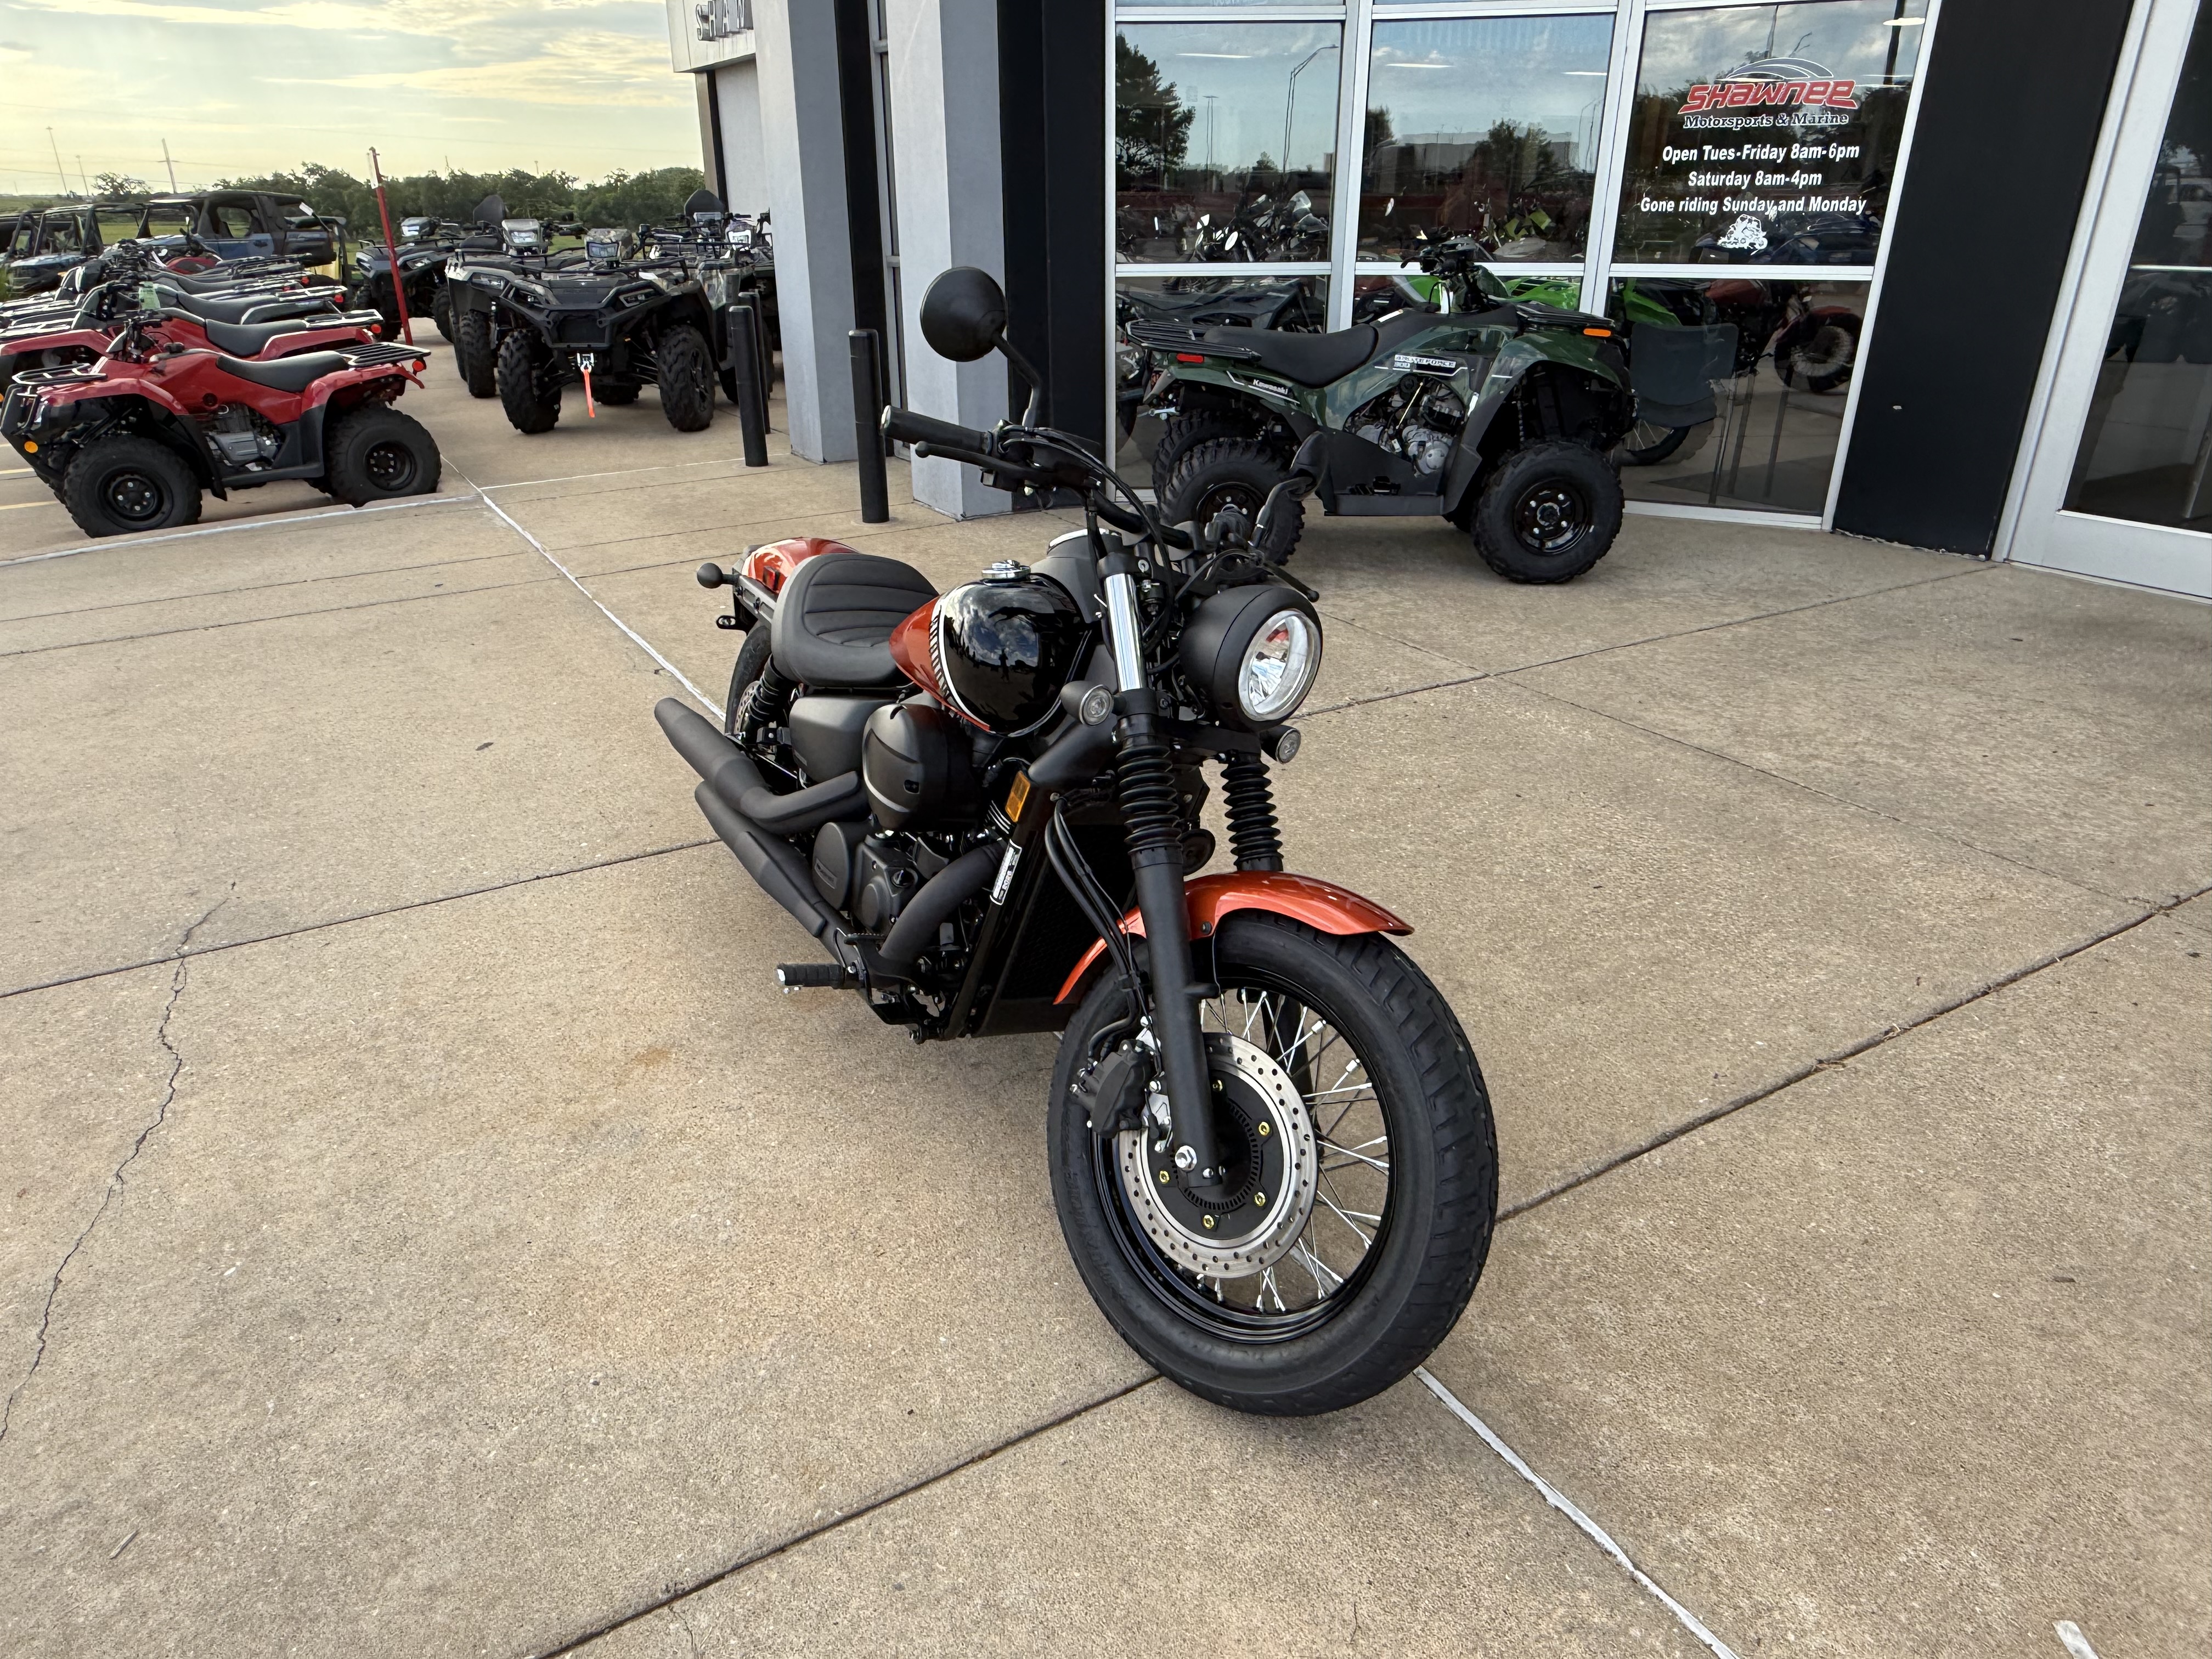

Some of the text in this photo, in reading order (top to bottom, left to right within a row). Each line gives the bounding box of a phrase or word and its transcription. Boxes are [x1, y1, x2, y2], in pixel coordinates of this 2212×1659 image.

[1683, 111, 1849, 131] Motorsports & Marine
[1662, 145, 1698, 165] Open
[1702, 144, 1787, 163] Tues-Friday
[1688, 170, 1822, 190] Saturday 8am-4pm
[1640, 196, 1867, 216] Gone riding Sunday and Monday
